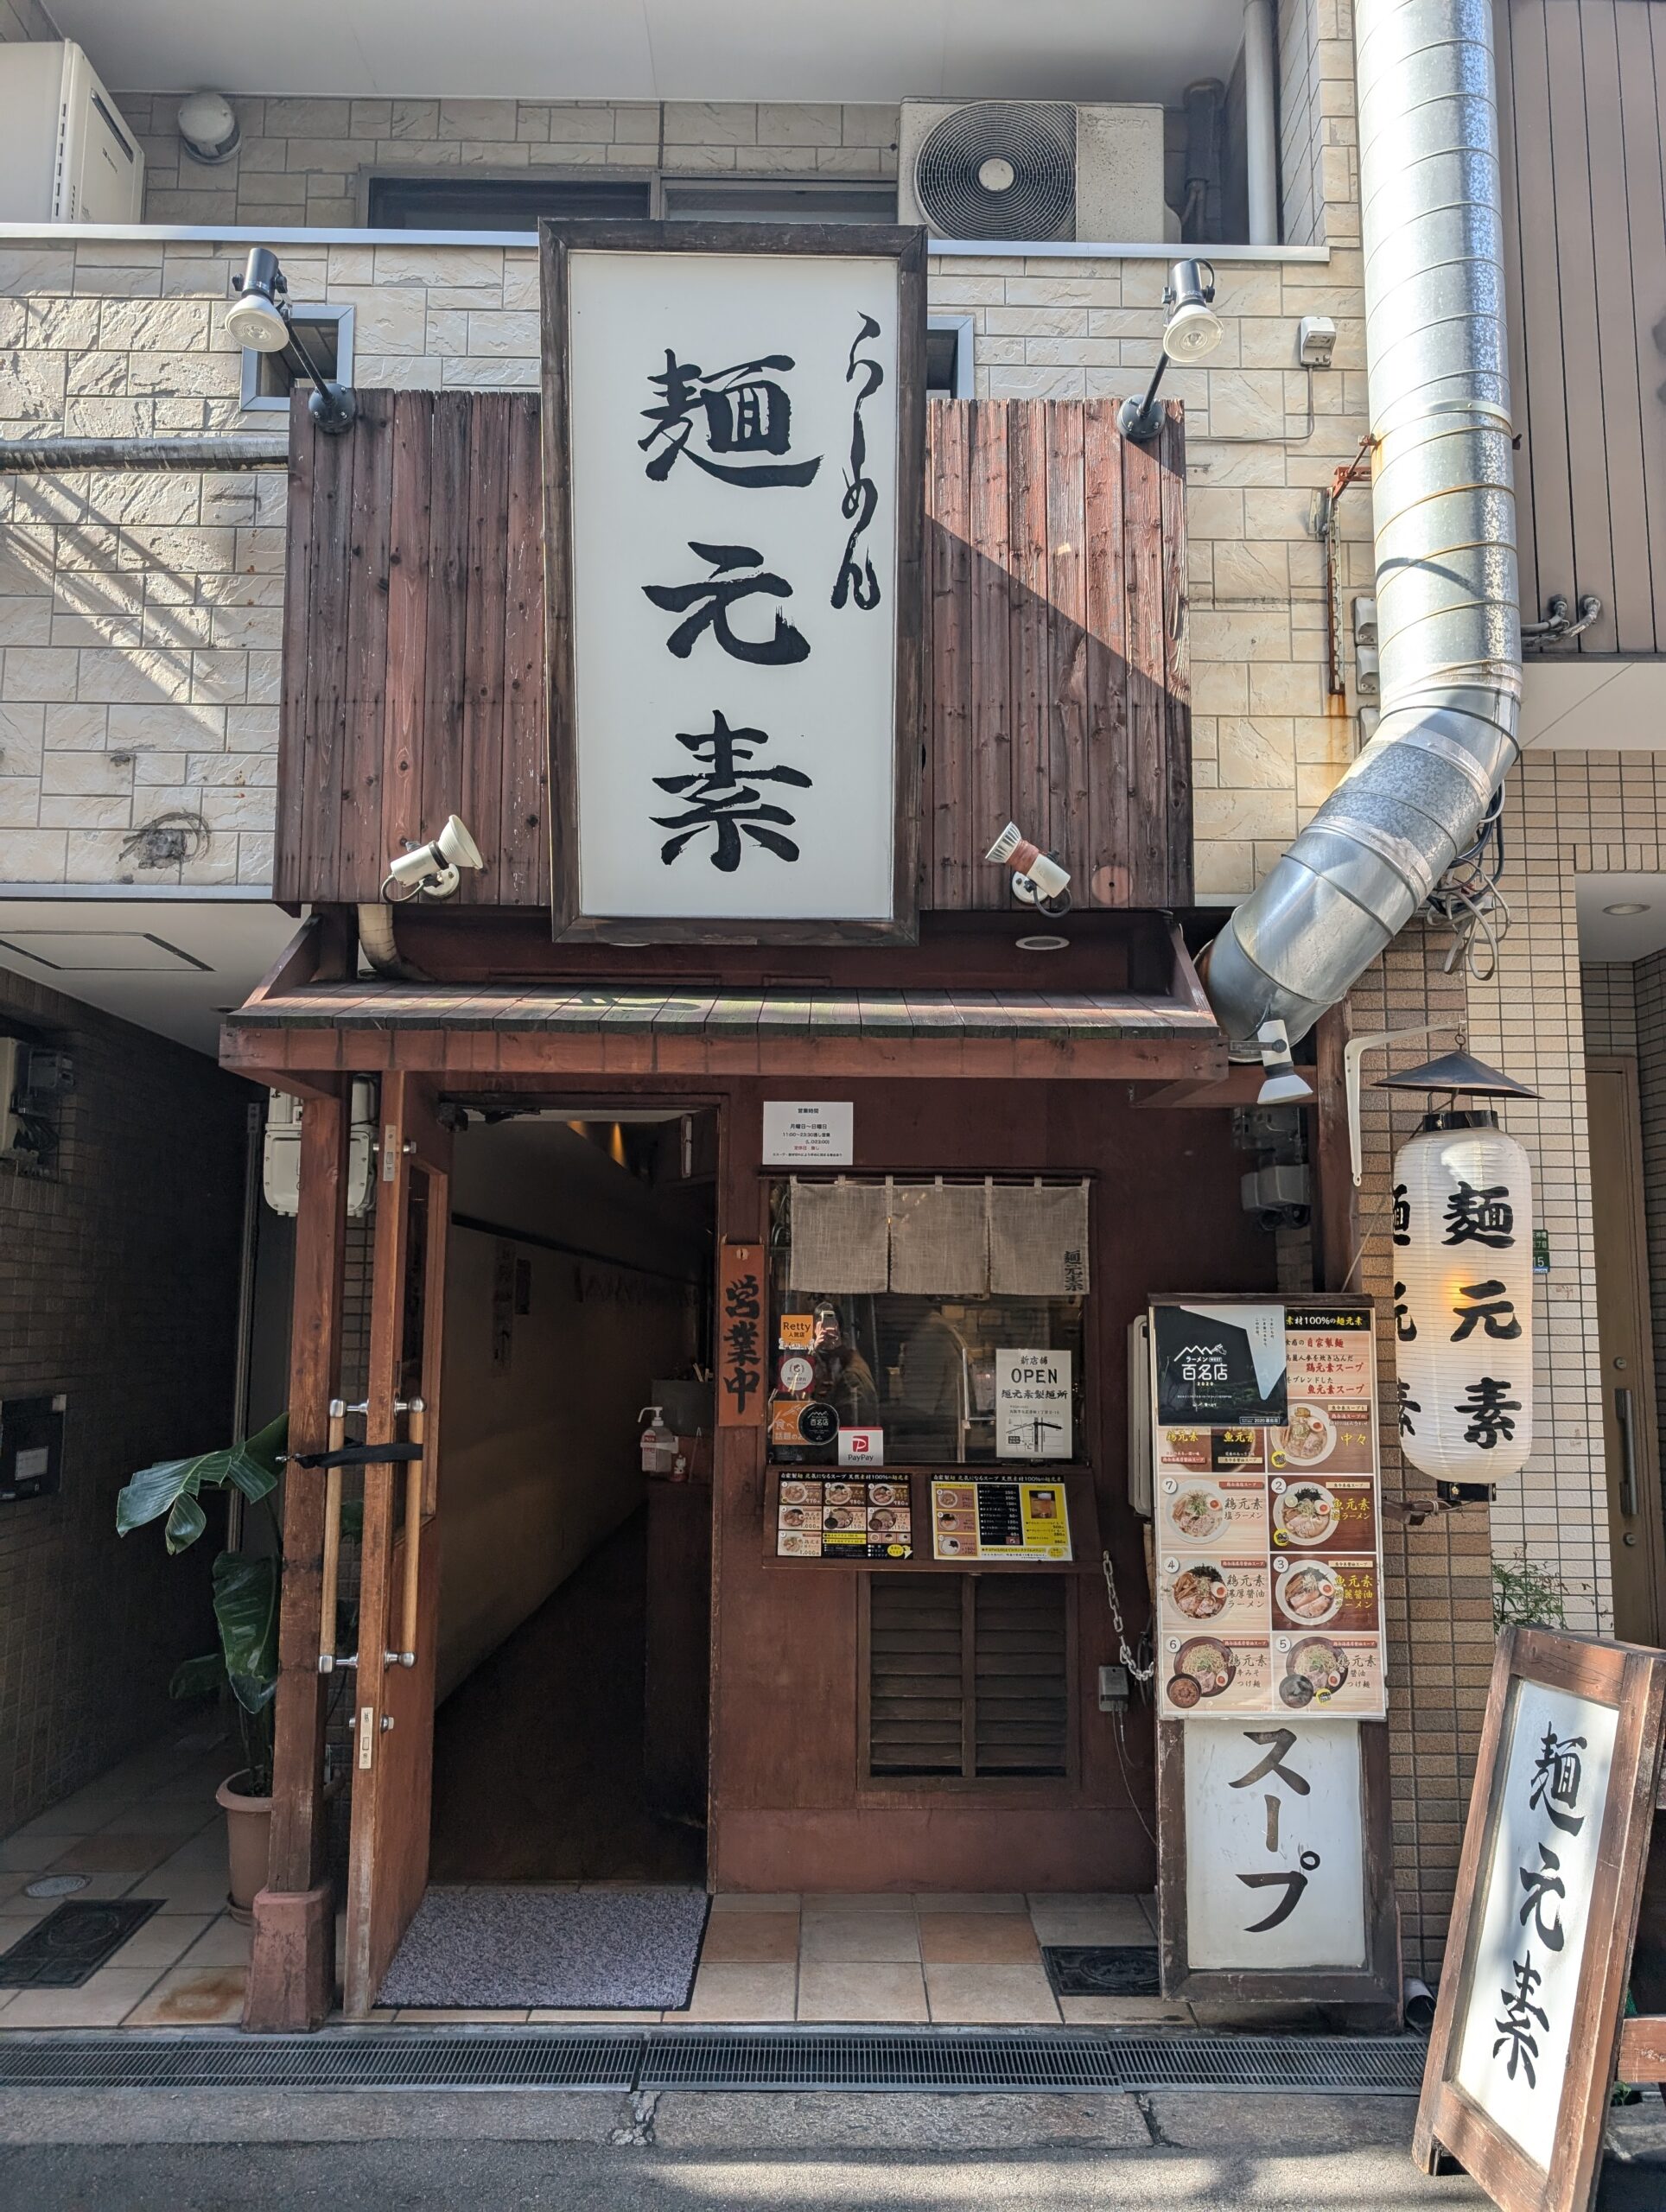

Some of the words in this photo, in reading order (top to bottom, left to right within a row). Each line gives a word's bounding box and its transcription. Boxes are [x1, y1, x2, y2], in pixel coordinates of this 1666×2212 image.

[636, 347, 825, 874] 麺元素
[1440, 1181, 1523, 1450] 麺元素
[783, 1321, 811, 1333] Retty
[722, 1274, 760, 1415] 営業中
[1011, 1368, 1058, 1384] OPEN
[1181, 1363, 1228, 1381] 百名店
[1340, 1432, 1366, 1446] 中々
[1166, 1480, 1173, 1490] 7
[1275, 1481, 1282, 1491] 2
[1224, 1497, 1263, 1510] 鶏元素
[1332, 1497, 1370, 1511] 魚元素
[1224, 1511, 1263, 1520] 塩ラーメン
[1168, 1560, 1175, 1569] 4
[1277, 1560, 1285, 1569] 3
[1227, 1574, 1265, 1586] 鶏元素
[1334, 1574, 1373, 1587] 魚元素
[1169, 1639, 1177, 1649] 6
[1280, 1639, 1287, 1649] 5
[1229, 1654, 1268, 1667] 鶏元素
[1237, 1669, 1259, 1677] 辛みそ
[1228, 1728, 1321, 1933] スープ
[1492, 1720, 1587, 2090] 麺元素
